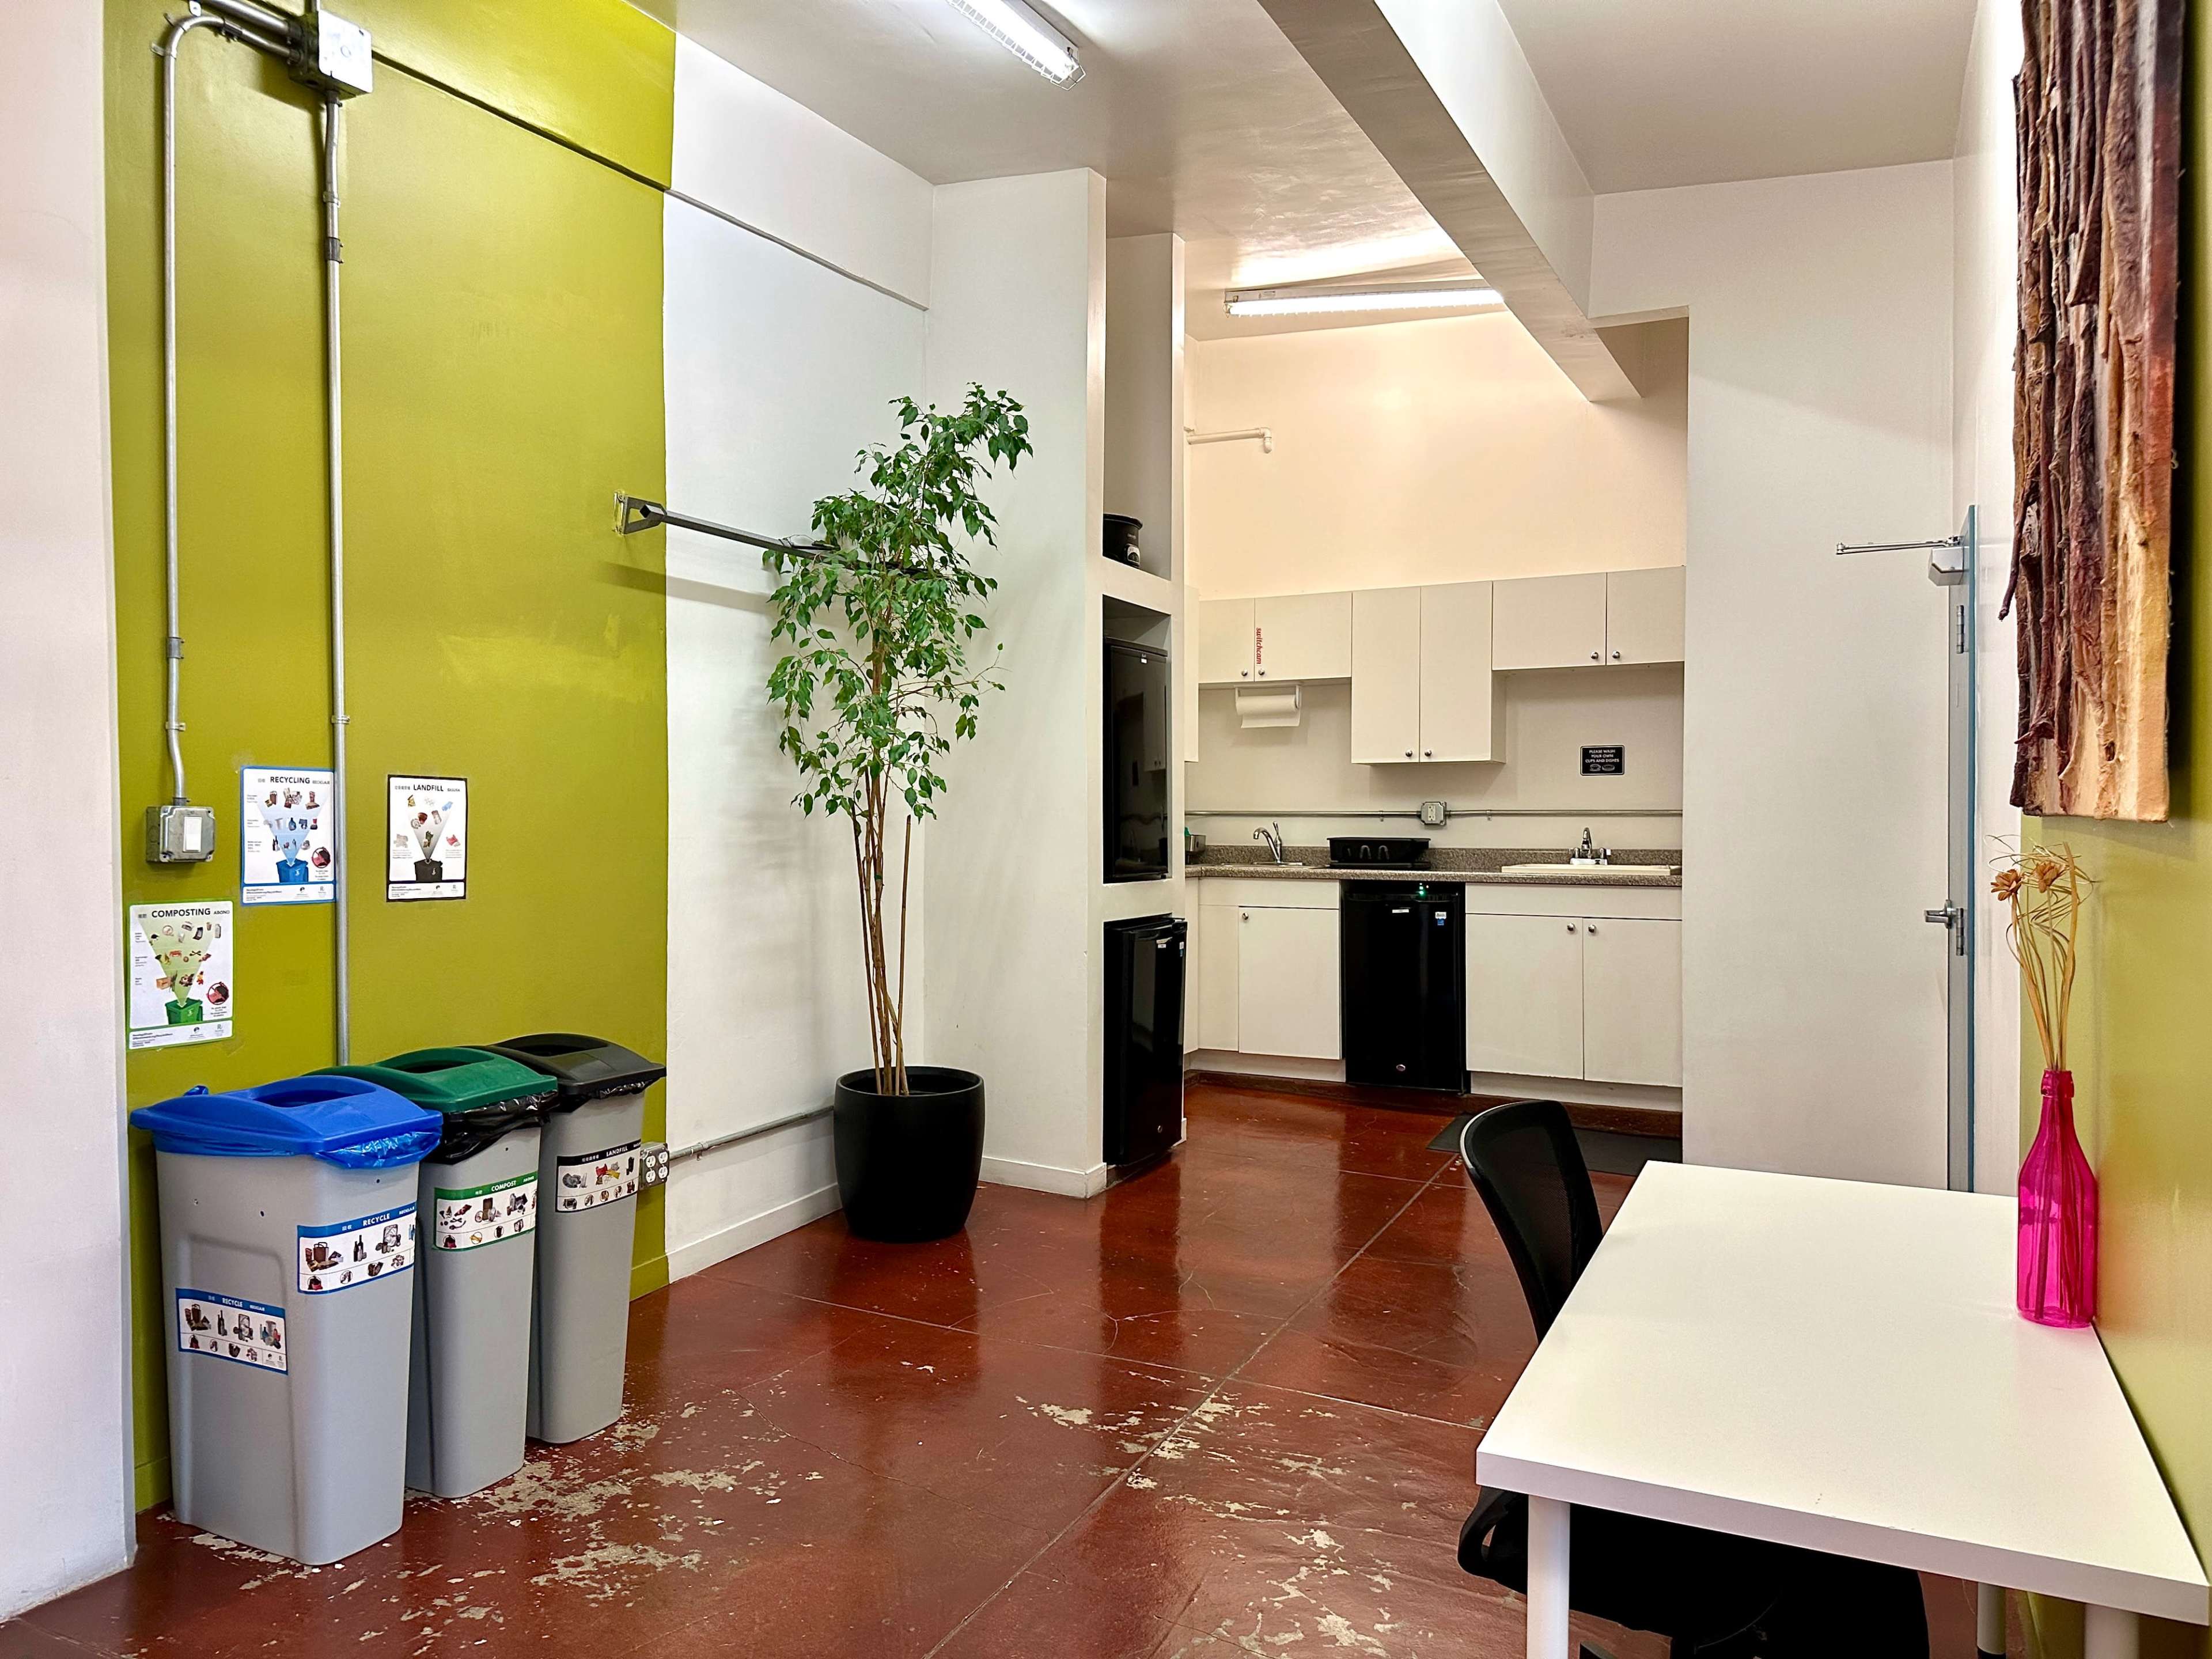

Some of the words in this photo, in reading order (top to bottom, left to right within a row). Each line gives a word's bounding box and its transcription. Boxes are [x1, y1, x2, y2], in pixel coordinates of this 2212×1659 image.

[151, 908, 211, 918] COMPOSTING
[606, 1146, 628, 1157] LANDFILL
[491, 1180, 516, 1192] COMPOST
[363, 1213, 390, 1226] RECYCLE
[222, 1298, 243, 1308] RECYCLE
